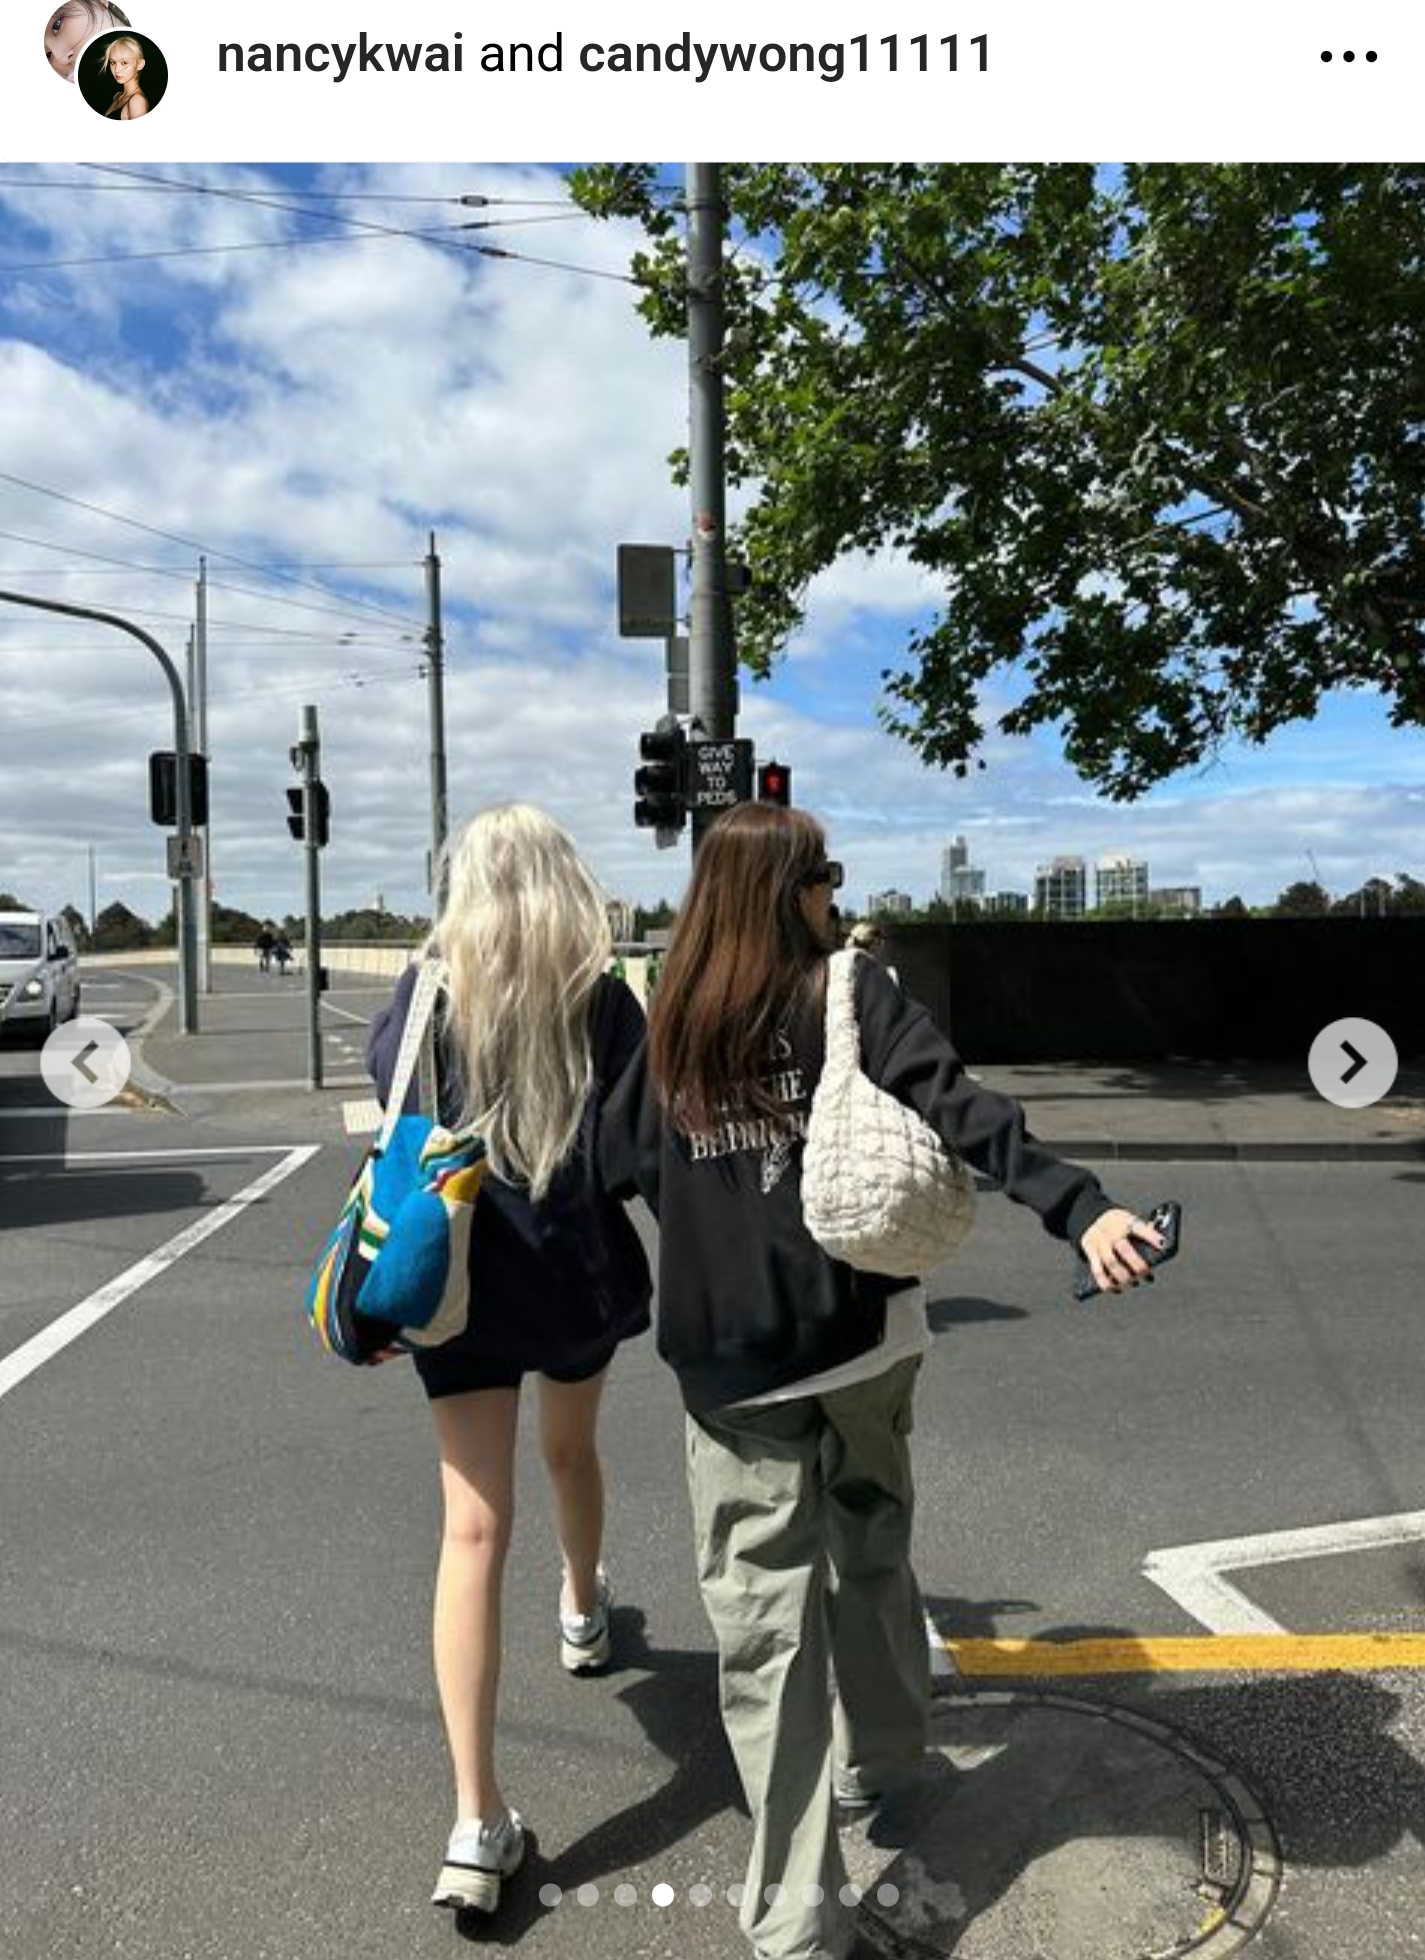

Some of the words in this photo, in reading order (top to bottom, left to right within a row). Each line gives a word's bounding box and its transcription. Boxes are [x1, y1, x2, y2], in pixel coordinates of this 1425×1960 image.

[698, 744, 734, 760] GIVE
[698, 760, 733, 775] WAY
[706, 776, 727, 790] TO
[697, 790, 738, 805] PEDS
